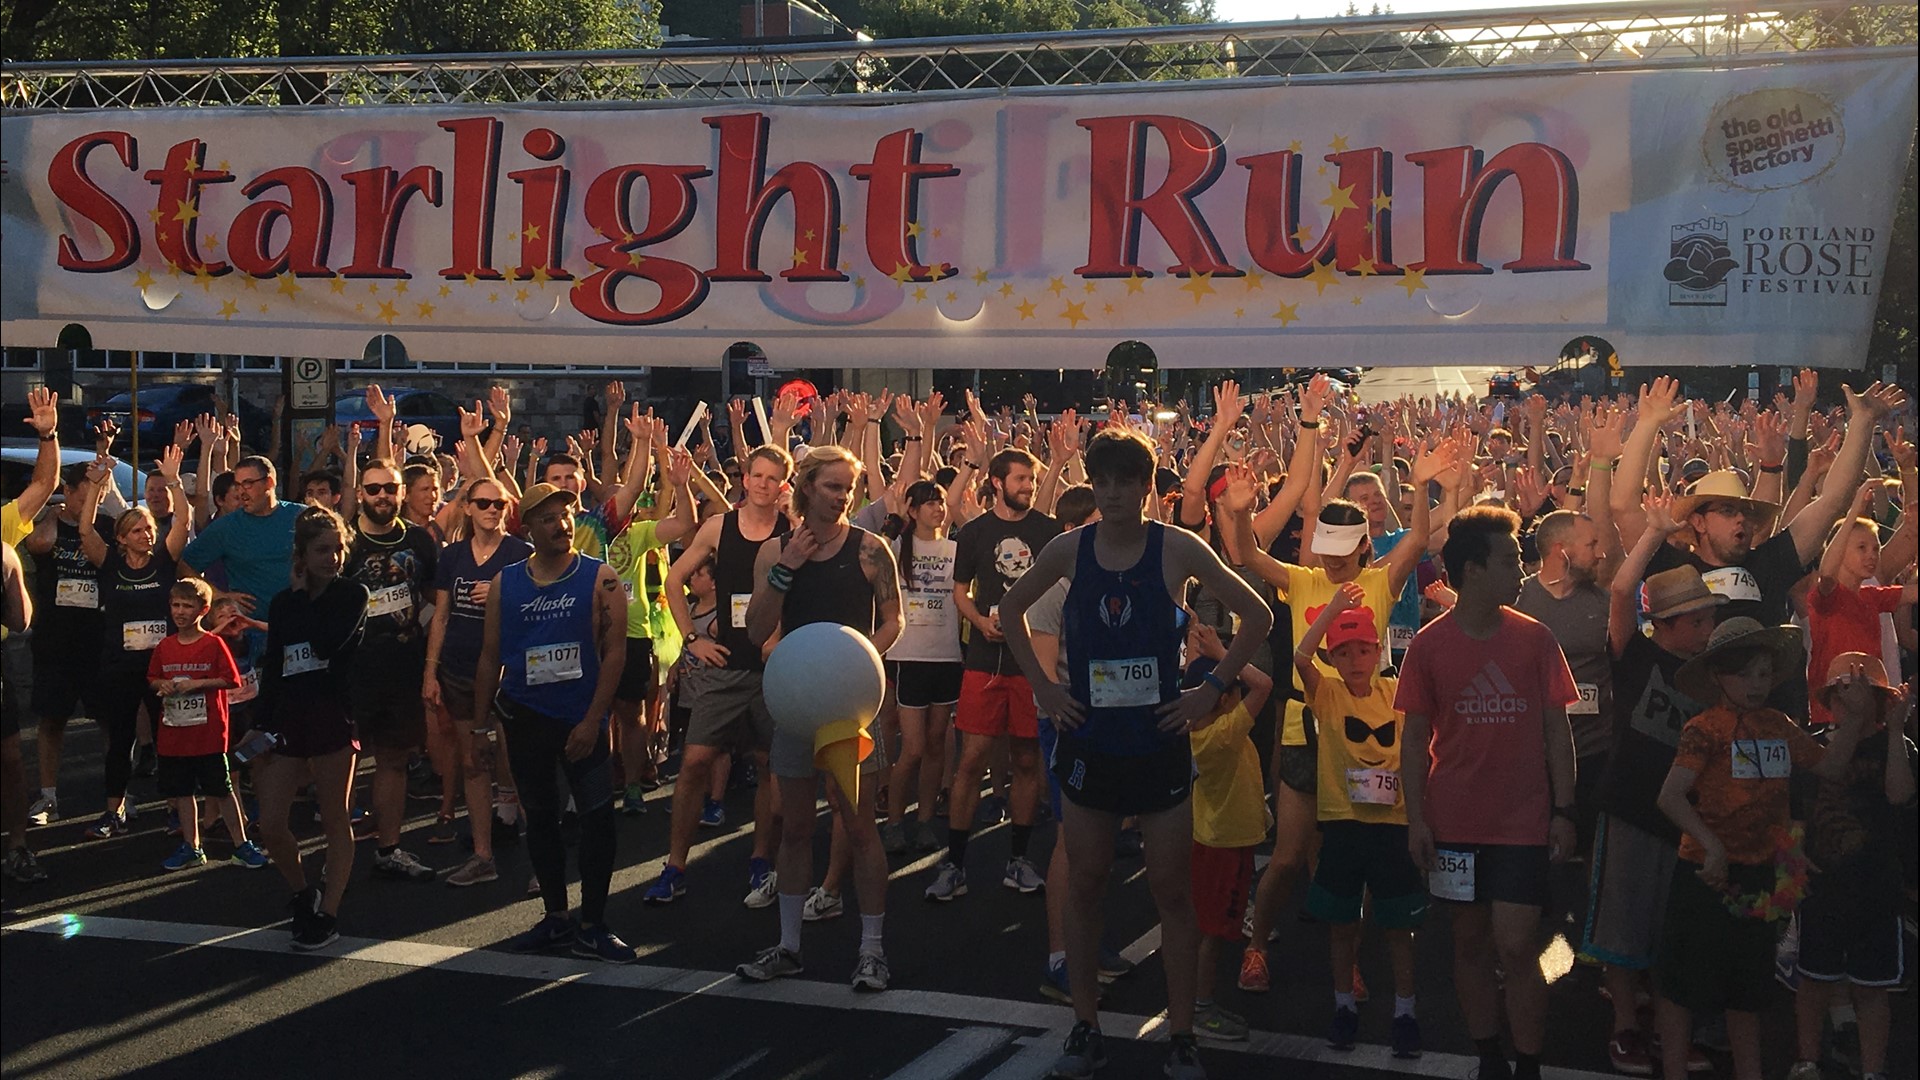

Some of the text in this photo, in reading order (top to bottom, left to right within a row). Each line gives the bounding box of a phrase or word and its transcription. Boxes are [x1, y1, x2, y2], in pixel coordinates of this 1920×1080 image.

[1721, 104, 1803, 139] the old
[1725, 117, 1834, 159] spaghetti
[1729, 143, 1814, 176] factory
[48, 112, 1591, 325] Starlight Run
[1742, 227, 1875, 242] PORTLAND
[1742, 242, 1873, 278] ROSE
[1742, 279, 1872, 295] FESTIVAL
[304, 362, 317, 376] P
[307, 385, 312, 393] 1
[1731, 573, 1755, 587] 745
[77, 583, 96, 593] 705
[386, 586, 409, 602] 1599
[520, 593, 576, 612] Alaska
[927, 600, 943, 609] 822
[523, 610, 571, 621] AIRLINES
[142, 625, 166, 634] 1438
[1393, 629, 1413, 640] 1225
[548, 647, 579, 661] 1077
[1120, 663, 1153, 680] 760
[177, 698, 204, 710] 1297
[1454, 693, 1528, 714] adidas
[1466, 716, 1516, 724] RUNNING
[1764, 746, 1786, 761] 747
[1375, 774, 1398, 791] 750
[1438, 856, 1468, 873] 354
